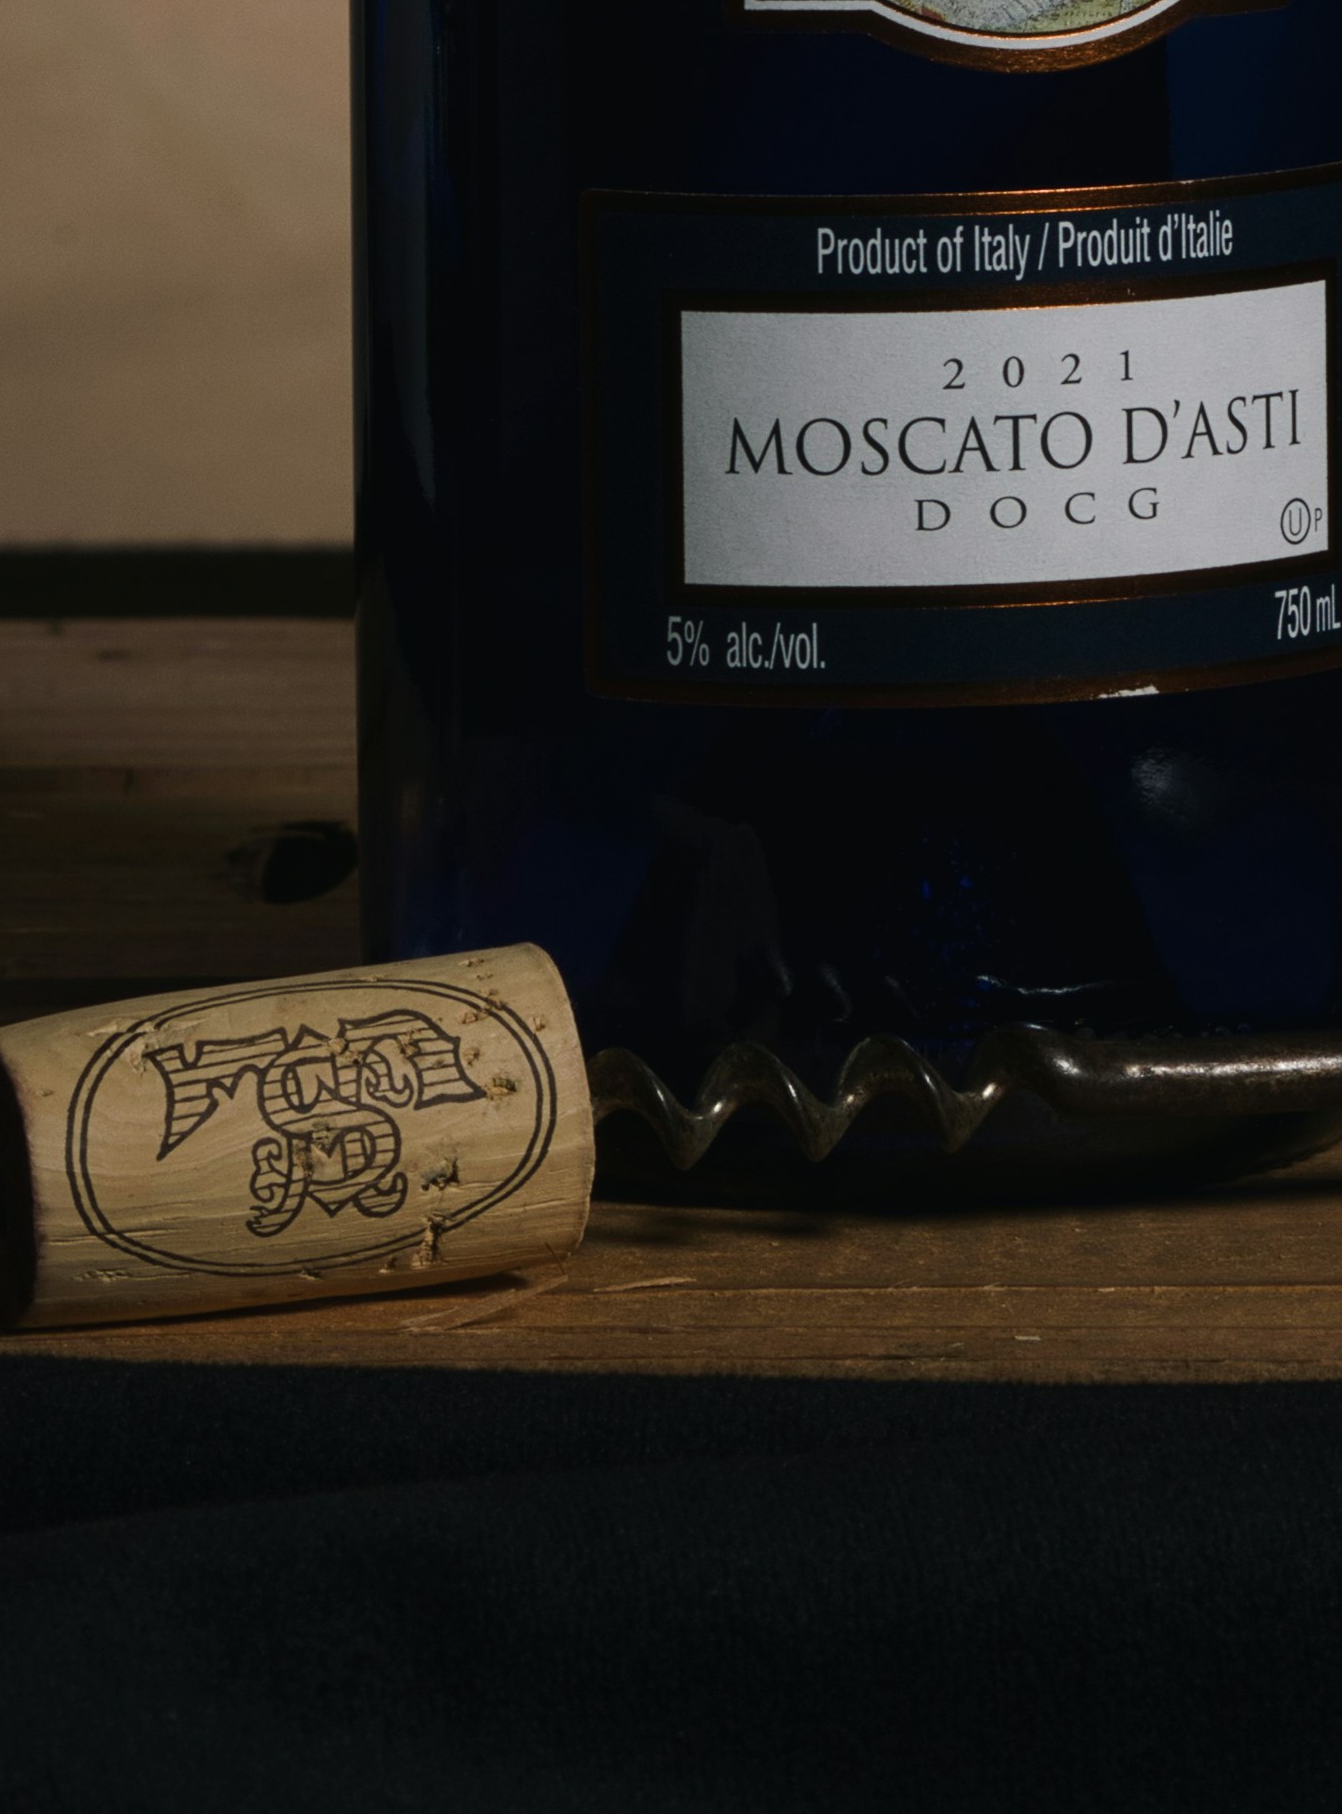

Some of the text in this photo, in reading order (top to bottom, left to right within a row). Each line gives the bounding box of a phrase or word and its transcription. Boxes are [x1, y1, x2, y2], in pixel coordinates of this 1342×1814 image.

[816, 226, 929, 276] Product
[935, 224, 966, 275] of
[973, 222, 1033, 282] Italy
[1057, 214, 1152, 269] Produit
[1157, 209, 1235, 264] d'Italie
[724, 388, 1302, 478] MOSCATO D'ASTI
[665, 614, 827, 671] 5% alc./vol.
[1273, 583, 1342, 641] 750 mL
